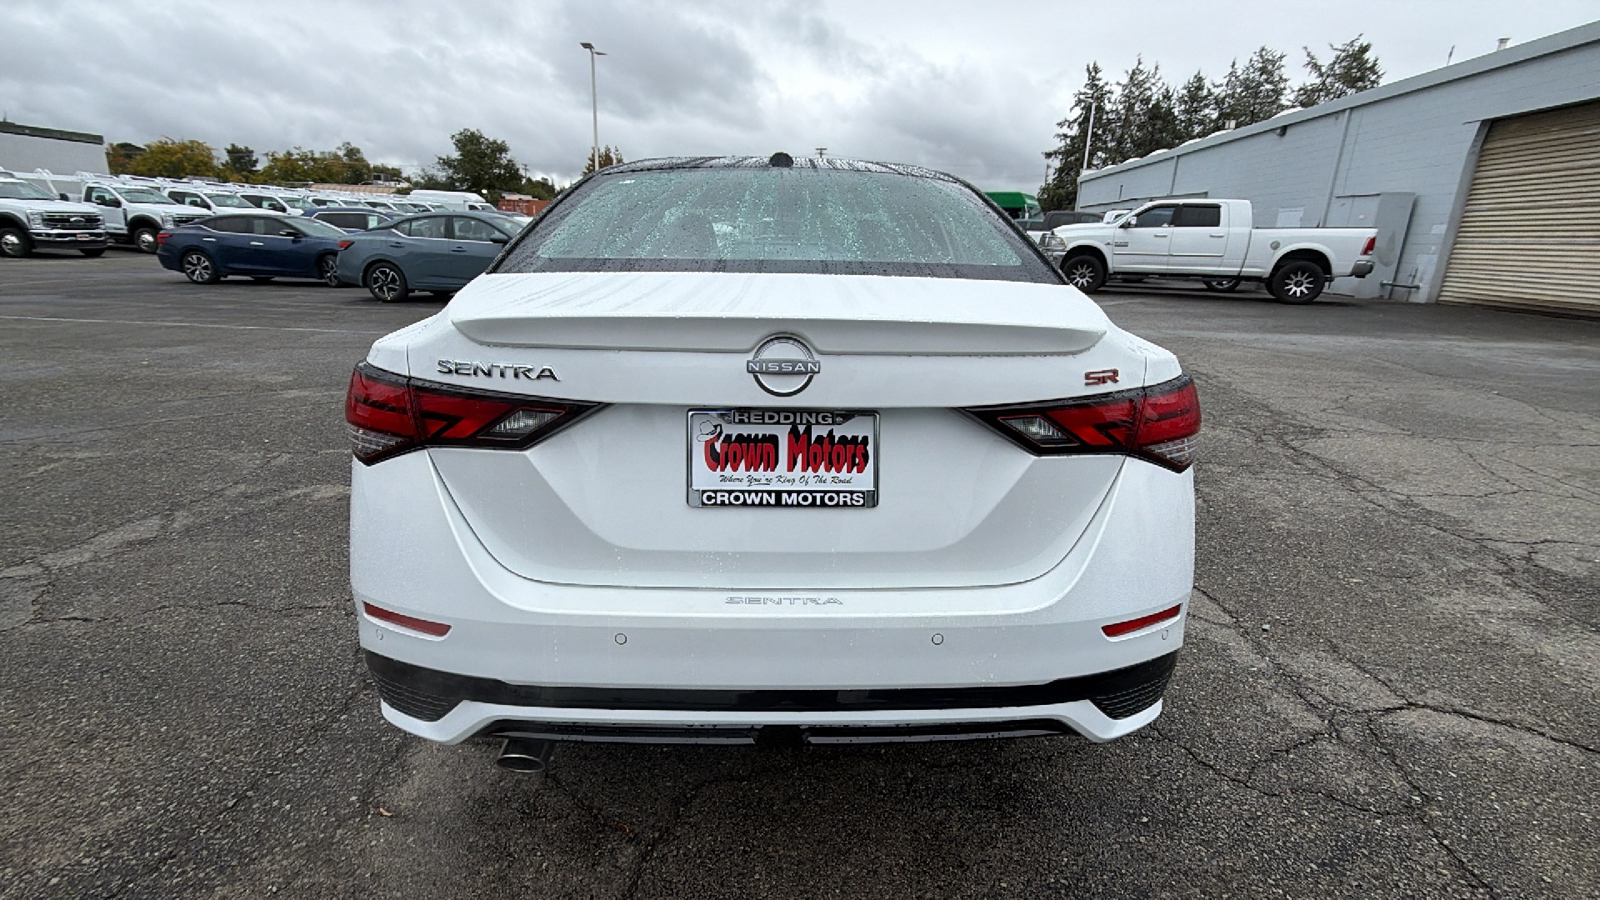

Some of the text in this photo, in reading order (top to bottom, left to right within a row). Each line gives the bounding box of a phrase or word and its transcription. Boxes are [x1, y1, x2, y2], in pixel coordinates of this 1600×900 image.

[437, 359, 560, 381] SENTRA
[748, 362, 819, 372] NISSAN
[1084, 369, 1119, 386] SR
[734, 411, 833, 424] REDDING
[704, 425, 869, 474] Crown Motors
[719, 474, 744, 483] Where
[775, 474, 796, 486] King
[798, 474, 810, 486] Of
[812, 474, 828, 484] The
[830, 475, 853, 484] Road
[702, 491, 865, 506] CROWN MOTORS
[725, 597, 844, 605] SENTRA
